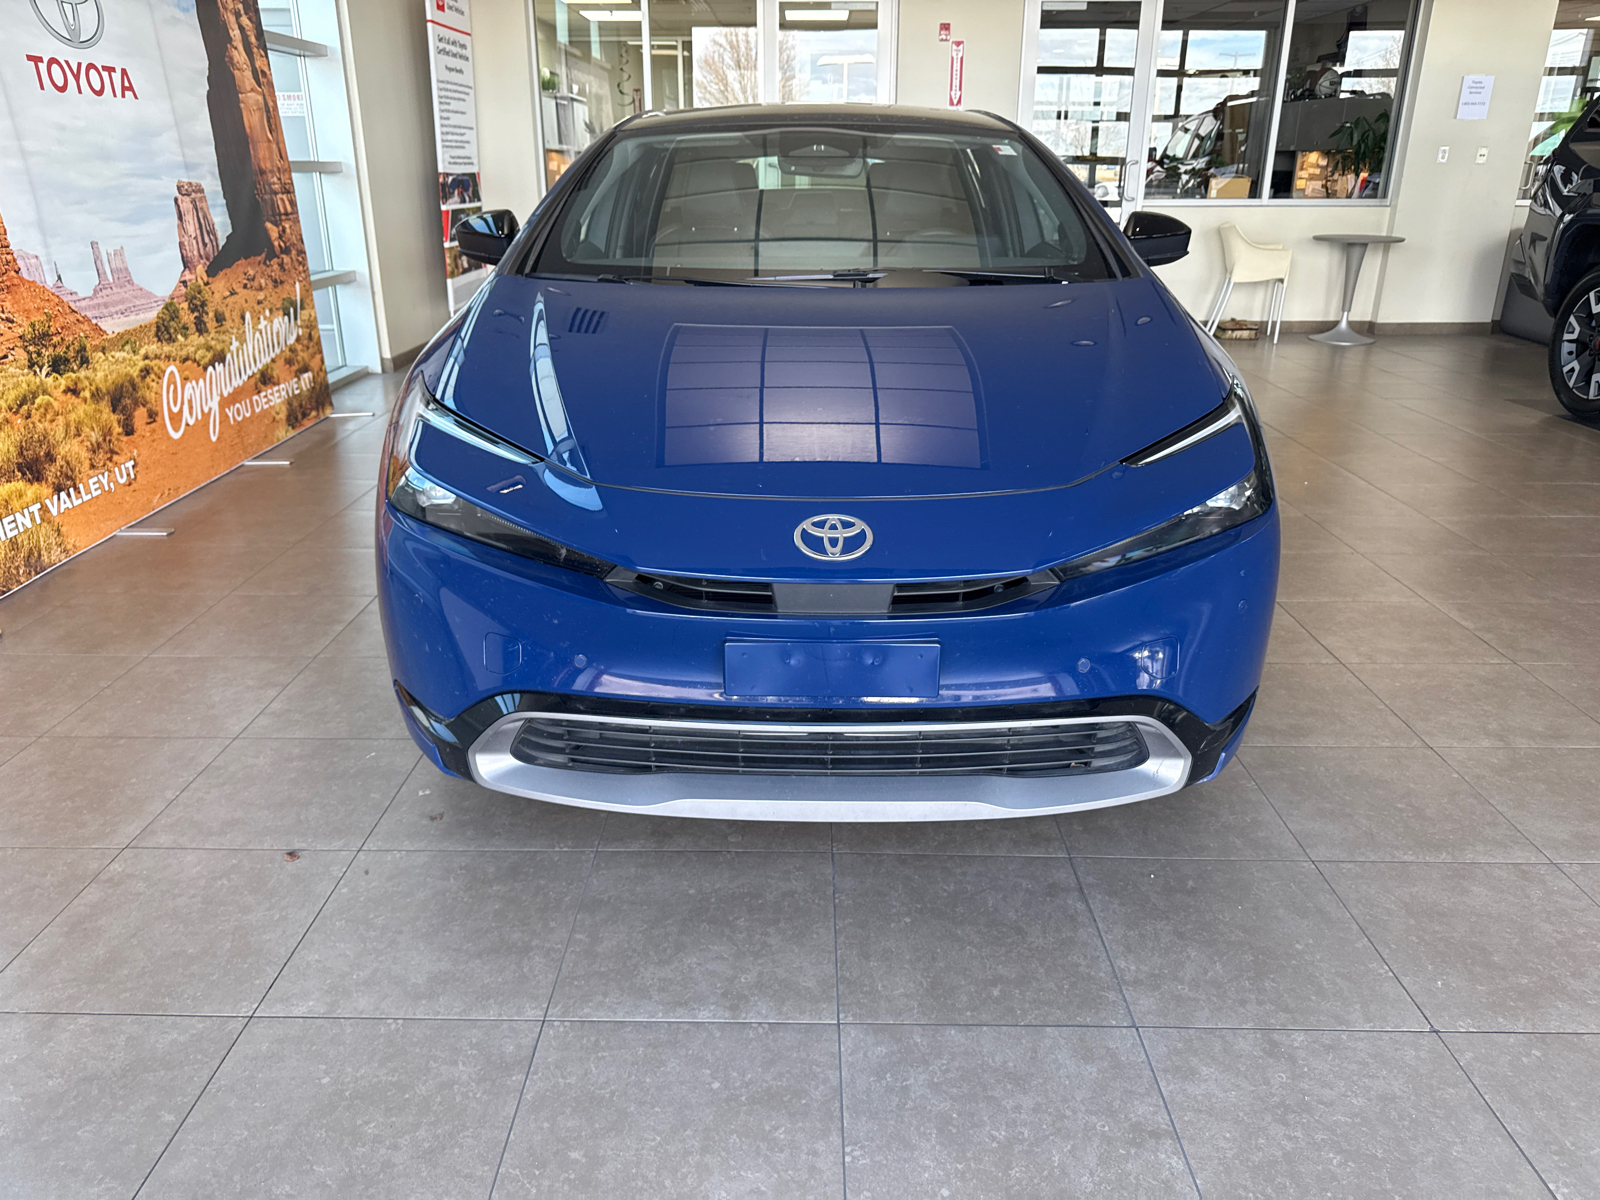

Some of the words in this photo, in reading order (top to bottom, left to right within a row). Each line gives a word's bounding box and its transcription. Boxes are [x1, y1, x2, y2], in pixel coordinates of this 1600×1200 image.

[25, 53, 139, 100] TOYOTA
[163, 281, 303, 442] Congratulations!
[225, 399, 251, 424] YOU
[252, 378, 300, 413] DESERVE
[300, 371, 315, 391] IT!
[44, 471, 115, 517] VALLEY,
[114, 460, 135, 484] UT
